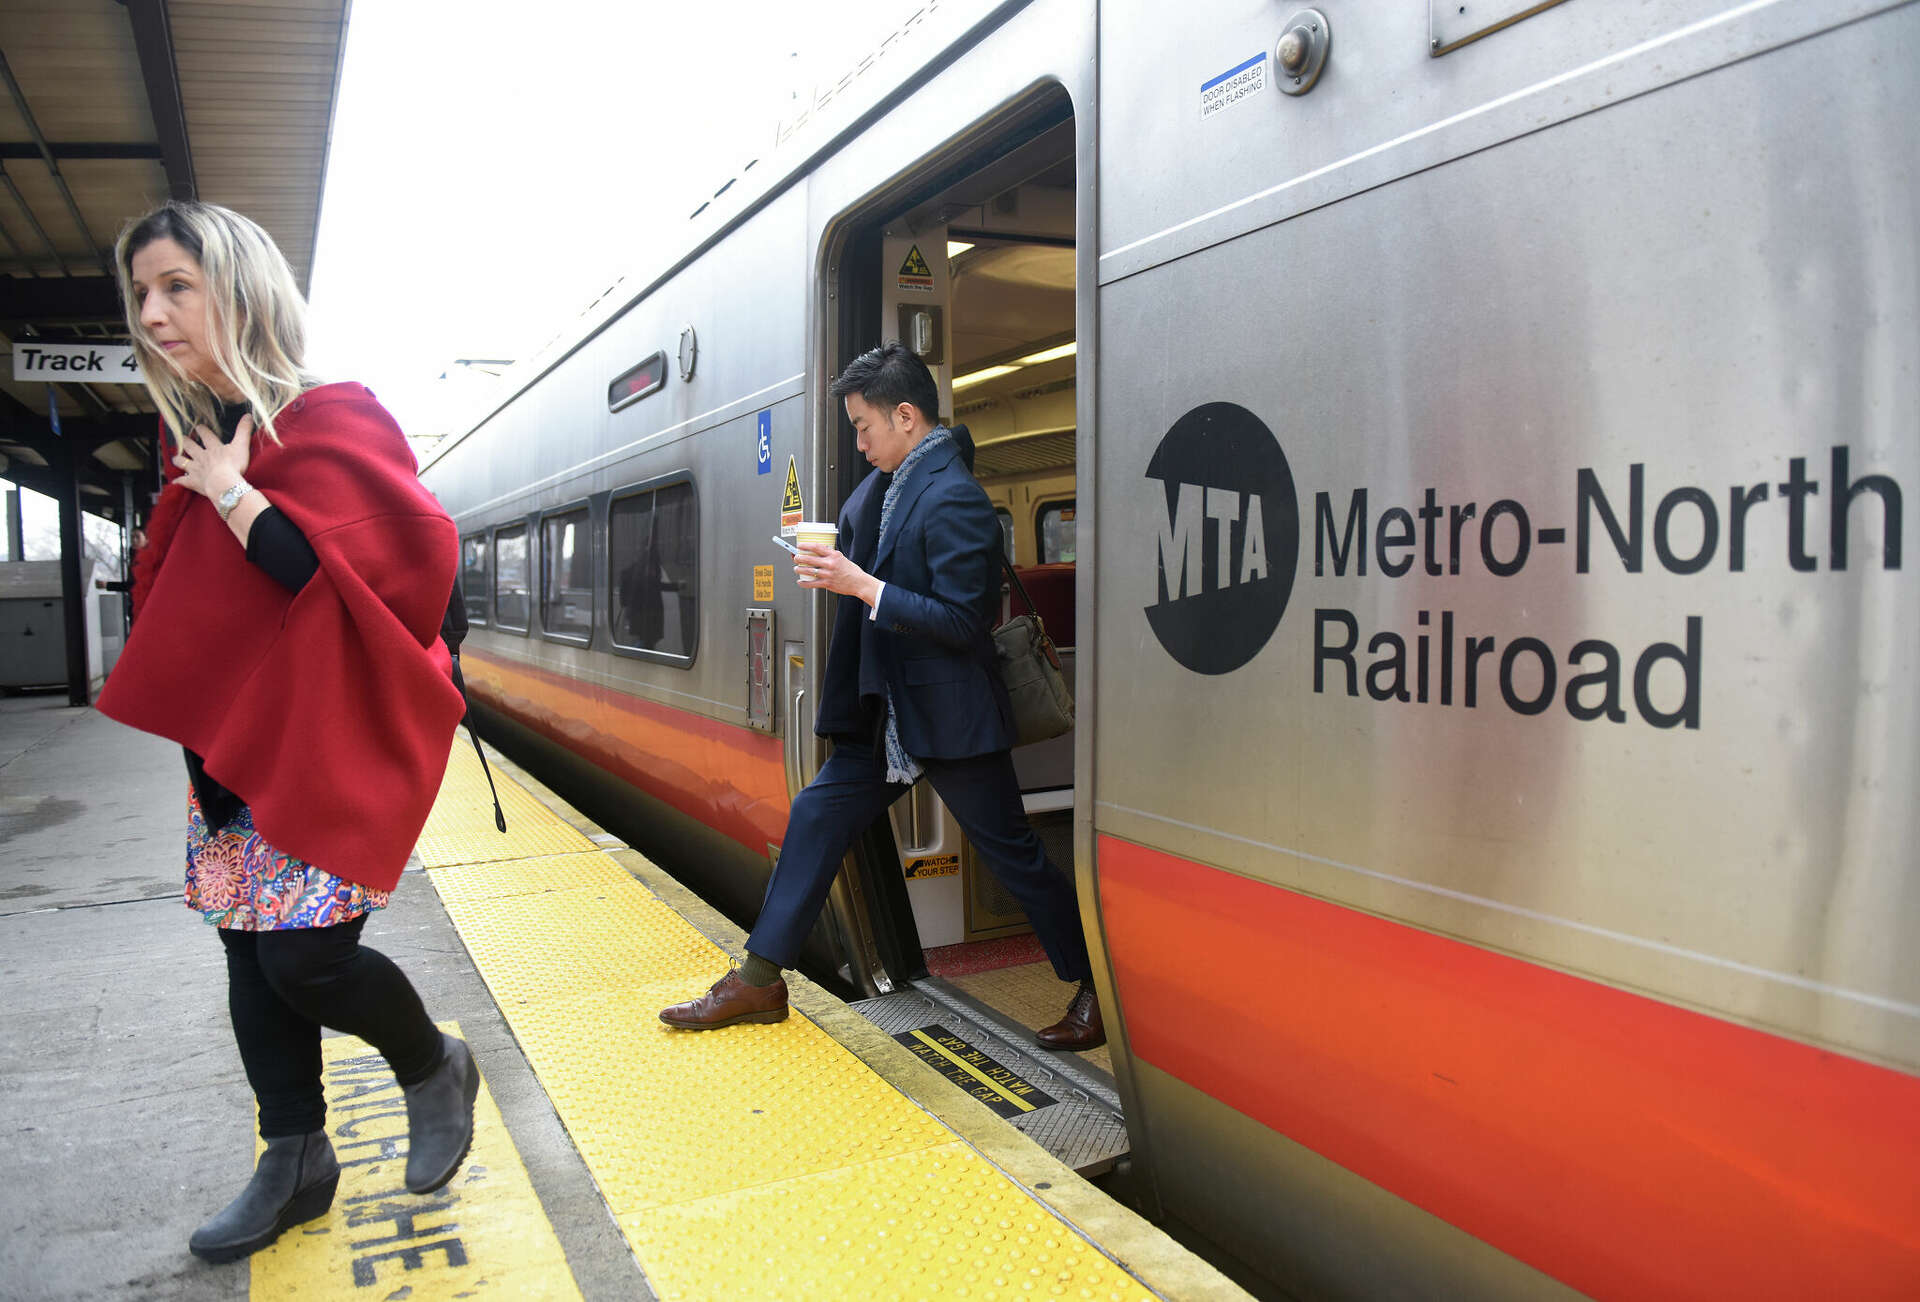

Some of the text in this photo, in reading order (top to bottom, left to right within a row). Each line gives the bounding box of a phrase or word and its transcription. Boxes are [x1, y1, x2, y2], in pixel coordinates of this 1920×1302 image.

[1203, 66, 1262, 104] DOOR DISABLED
[1203, 79, 1262, 115] WHEN FLASHING
[21, 349, 138, 372] Track 4
[1314, 445, 1903, 578] Metro-North
[1156, 482, 1268, 602] MTA
[1313, 608, 1703, 730] Railroad
[917, 865, 959, 877] YOUR STEP
[924, 856, 951, 867] WATCH
[908, 1043, 1003, 1103] WATCH THE GAP
[938, 1036, 1036, 1096] WATCH THE GAP
[342, 1185, 469, 1288] THE
